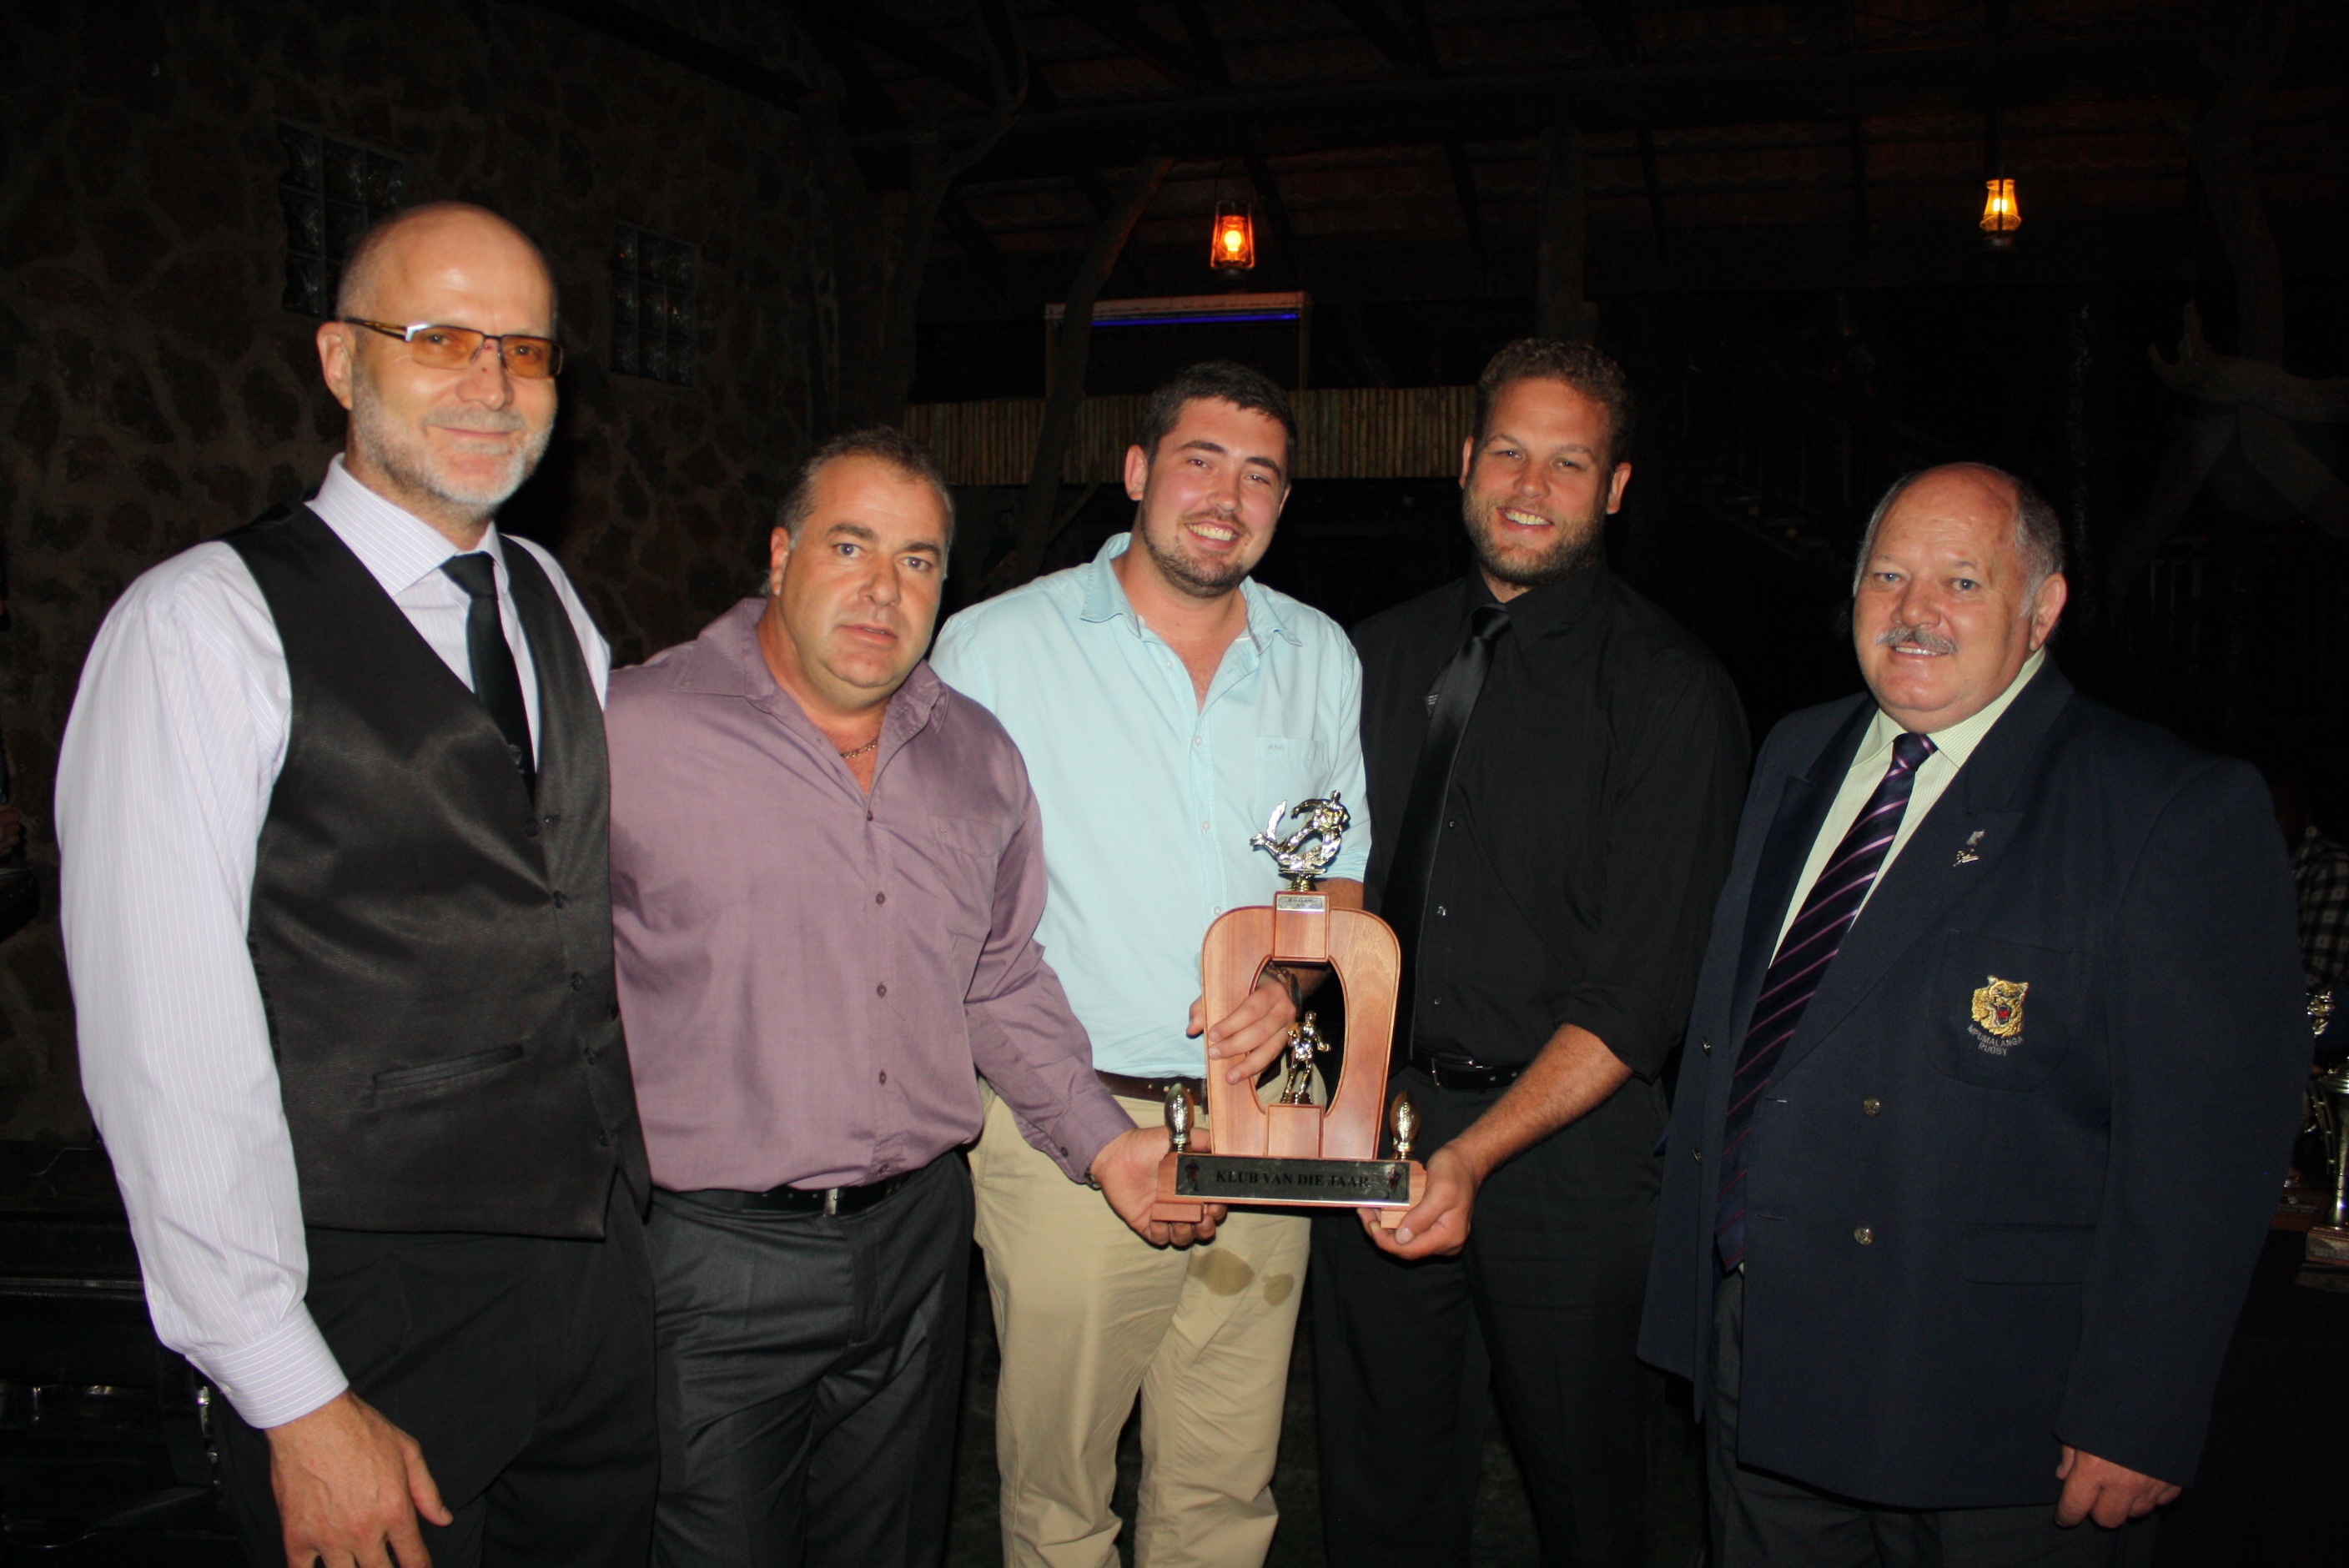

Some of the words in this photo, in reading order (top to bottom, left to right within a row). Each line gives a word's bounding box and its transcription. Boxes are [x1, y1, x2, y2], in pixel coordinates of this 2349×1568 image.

[1967, 1024, 2024, 1047] MPUMALANGA
[1978, 1043, 2008, 1055] RUGBY
[1215, 1171, 1258, 1184] KLUB
[1263, 1173, 1293, 1185] VAN
[1297, 1173, 1324, 1186] DIE
[1327, 1175, 1370, 1187] JAAR
